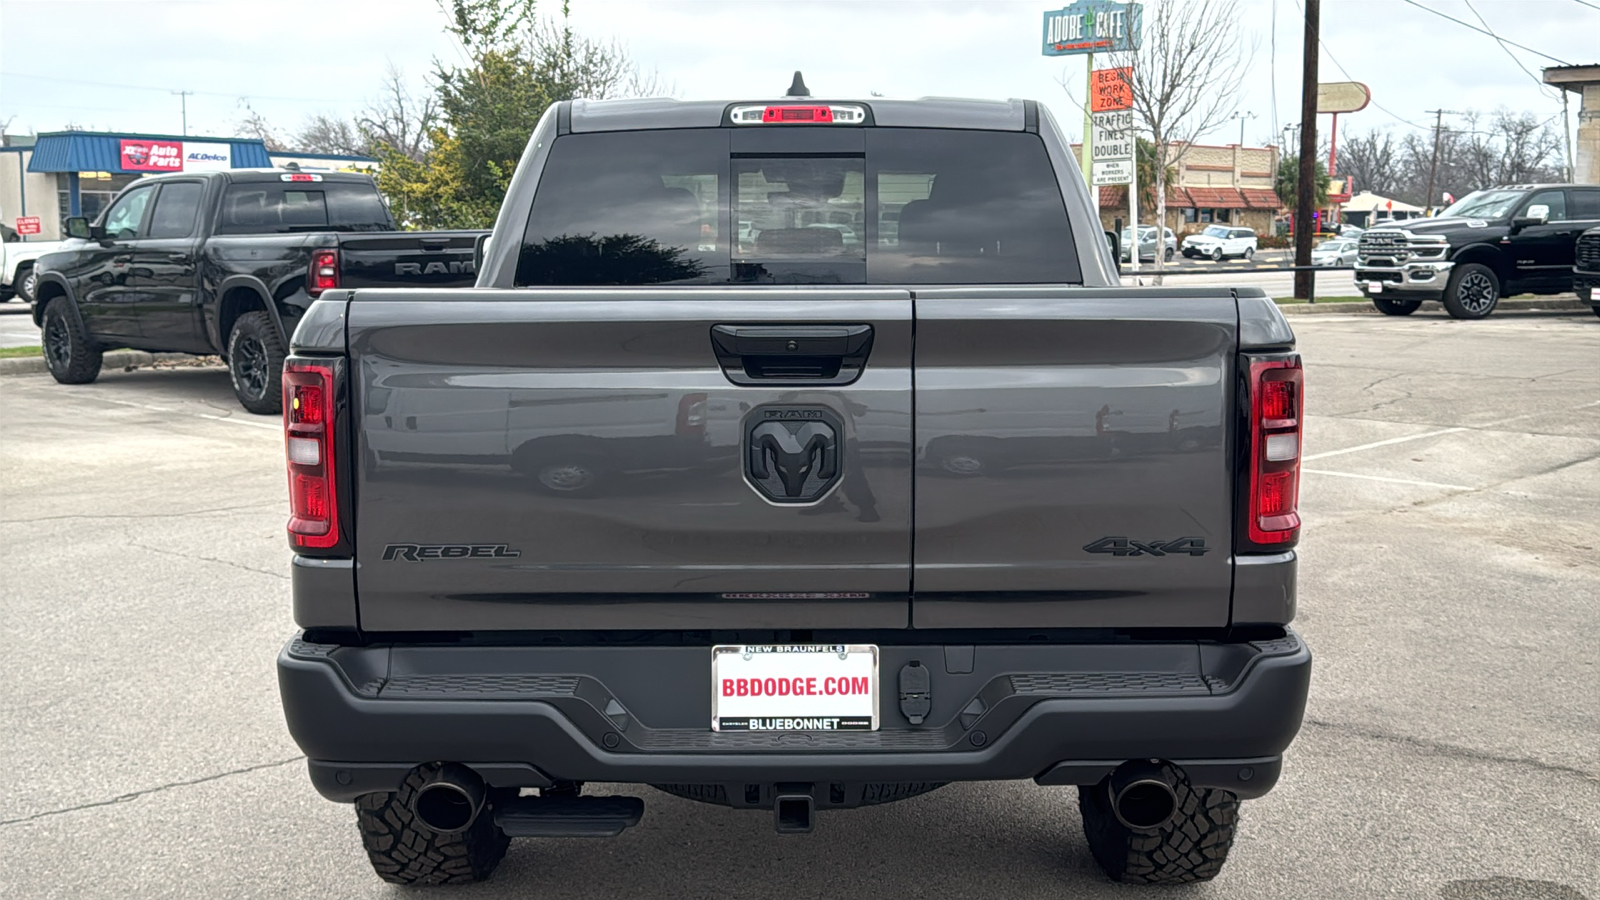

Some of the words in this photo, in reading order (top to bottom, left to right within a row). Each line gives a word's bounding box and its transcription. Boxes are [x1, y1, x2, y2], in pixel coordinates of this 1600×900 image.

[1047, 14, 1084, 44] ADOBE
[1095, 10, 1124, 39] CAFE
[1098, 84, 1126, 96] WORK
[1100, 95, 1125, 108] ZONE
[1093, 113, 1131, 127] TRAFFIC
[1099, 130, 1125, 142] FINES
[149, 144, 178, 156] Auto
[1094, 143, 1130, 157] DOUBLE
[148, 155, 181, 167] Parts
[188, 153, 228, 161] ACDelco
[394, 261, 476, 275] RAM
[764, 410, 823, 418] RAM
[1082, 536, 1211, 557] 4x4
[381, 543, 522, 563] REBEL
[747, 645, 773, 653] NEW
[776, 645, 844, 653] BRAUNFELS
[722, 677, 869, 697] BBDODGE.COM
[749, 718, 840, 730] BLUEBONNET
